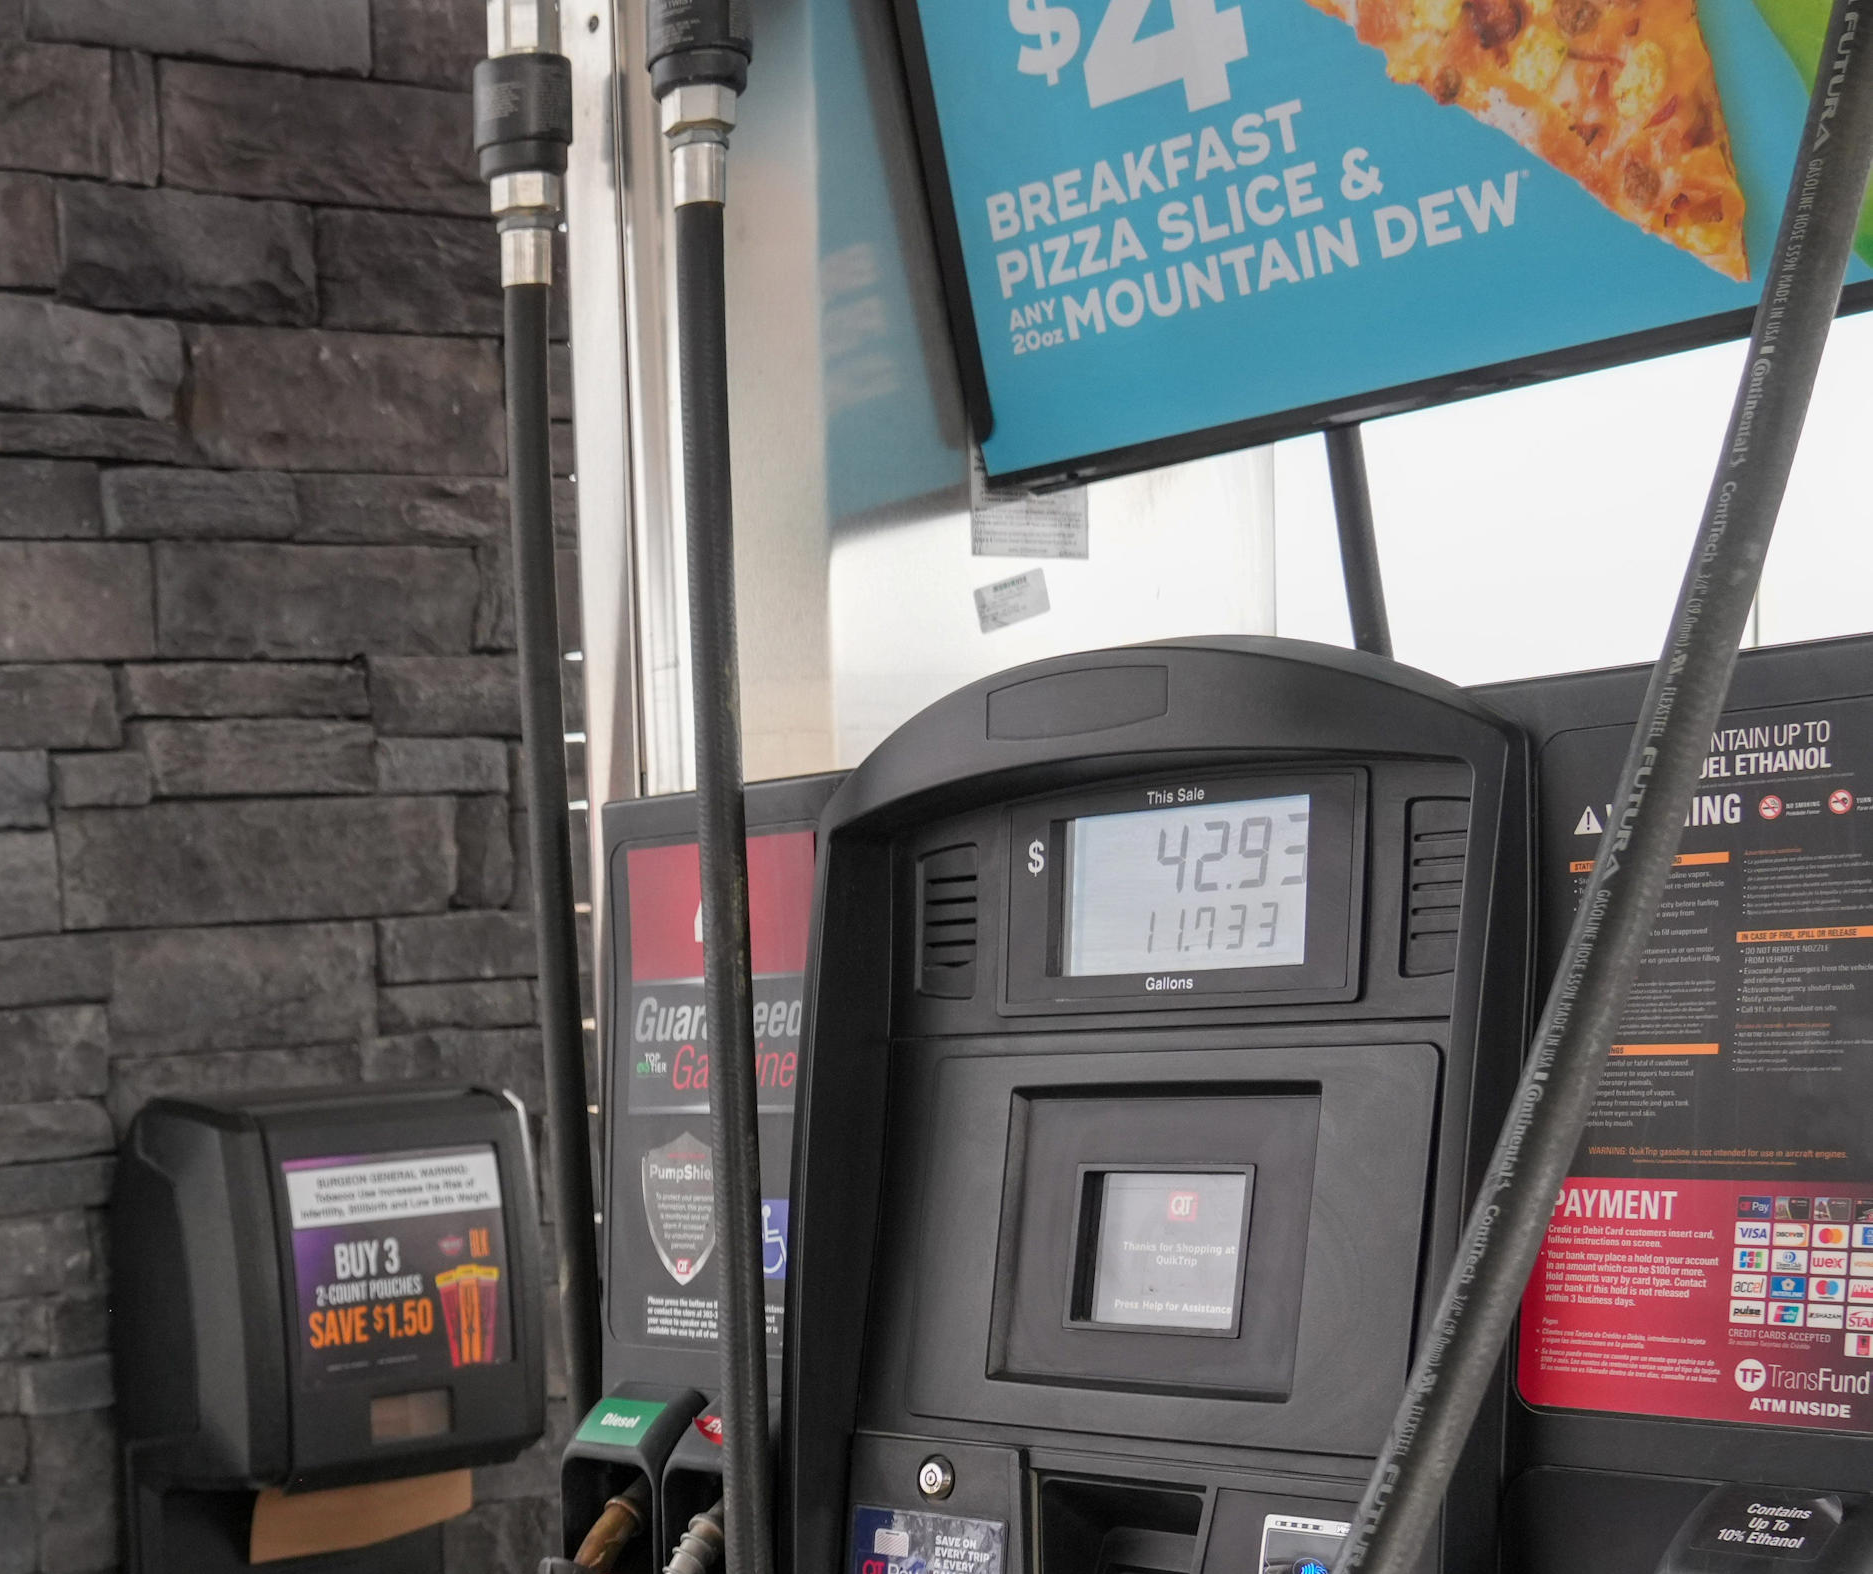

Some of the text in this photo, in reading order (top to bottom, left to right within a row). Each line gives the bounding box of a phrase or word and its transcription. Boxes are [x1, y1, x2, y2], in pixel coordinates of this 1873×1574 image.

[1008, 0, 1248, 112] $4
[1813, 11, 1859, 152] FUTURA
[986, 99, 1302, 242] BREAKFAST
[1797, 159, 1824, 211] GASOLINE
[995, 147, 1383, 299] PIZZA SLICE &
[1791, 213, 1810, 240] HOSE
[1061, 217, 1360, 341] MOUNTAIN
[1008, 298, 1056, 333] ANY
[1011, 326, 1065, 356] 20oz
[1705, 482, 1736, 563] ContiTech
[1709, 720, 1830, 753] NTAIN UP TO
[1735, 747, 1831, 775] ETHANOL
[1603, 686, 1678, 881] FLEXSTEEL FUTURA
[1147, 787, 1205, 805] This Sale
[1027, 839, 1045, 877] $
[1750, 931, 1768, 941] CASE
[1828, 928, 1858, 937] RELEASE
[1144, 975, 1194, 992] Gallons
[634, 996, 803, 1042] Guareed
[645, 1052, 661, 1063] TOP
[649, 1061, 667, 1073] TIER
[672, 1041, 797, 1091] Gaine
[649, 1163, 712, 1183] PumpShie
[1551, 1188, 1678, 1220] PAYMENT
[1547, 1235, 1573, 1245] follow
[1573, 1236, 1620, 1246] instructions
[1548, 1225, 1572, 1234] Credit
[1582, 1226, 1604, 1235] Debit
[1605, 1226, 1624, 1235] Card
[1625, 1228, 1667, 1238] customers
[1668, 1228, 1693, 1238] insert
[1739, 1227, 1767, 1239] VISA
[333, 1239, 379, 1280] BUY
[382, 1236, 401, 1275] 3
[1123, 1241, 1157, 1252] Thanks
[1176, 1242, 1222, 1257] Shopping
[1225, 1244, 1236, 1254] at
[315, 1273, 424, 1307] 2-COUNT POUCHES
[1734, 1278, 1764, 1293] accel
[1142, 1300, 1164, 1312] Help
[1165, 1302, 1178, 1311] for
[1181, 1303, 1232, 1314] Assistance
[1733, 1305, 1761, 1316] pulse
[308, 1296, 434, 1349] SAVE $1.50
[1728, 1328, 1831, 1343] CREDIT CARDS ACCEPTED
[1767, 1363, 1870, 1395] TransFund
[1749, 1397, 1851, 1418] ATM INSIDE
[600, 1412, 641, 1429] Diesel
[1746, 1503, 1812, 1519] Contains
[1748, 1517, 1790, 1531] Up To
[935, 1535, 977, 1549] SAVE ON
[1717, 1528, 1805, 1549] 10% Ethanol
[934, 1547, 990, 1562] EVERY TRIP
[943, 1560, 975, 1573] EVERY
